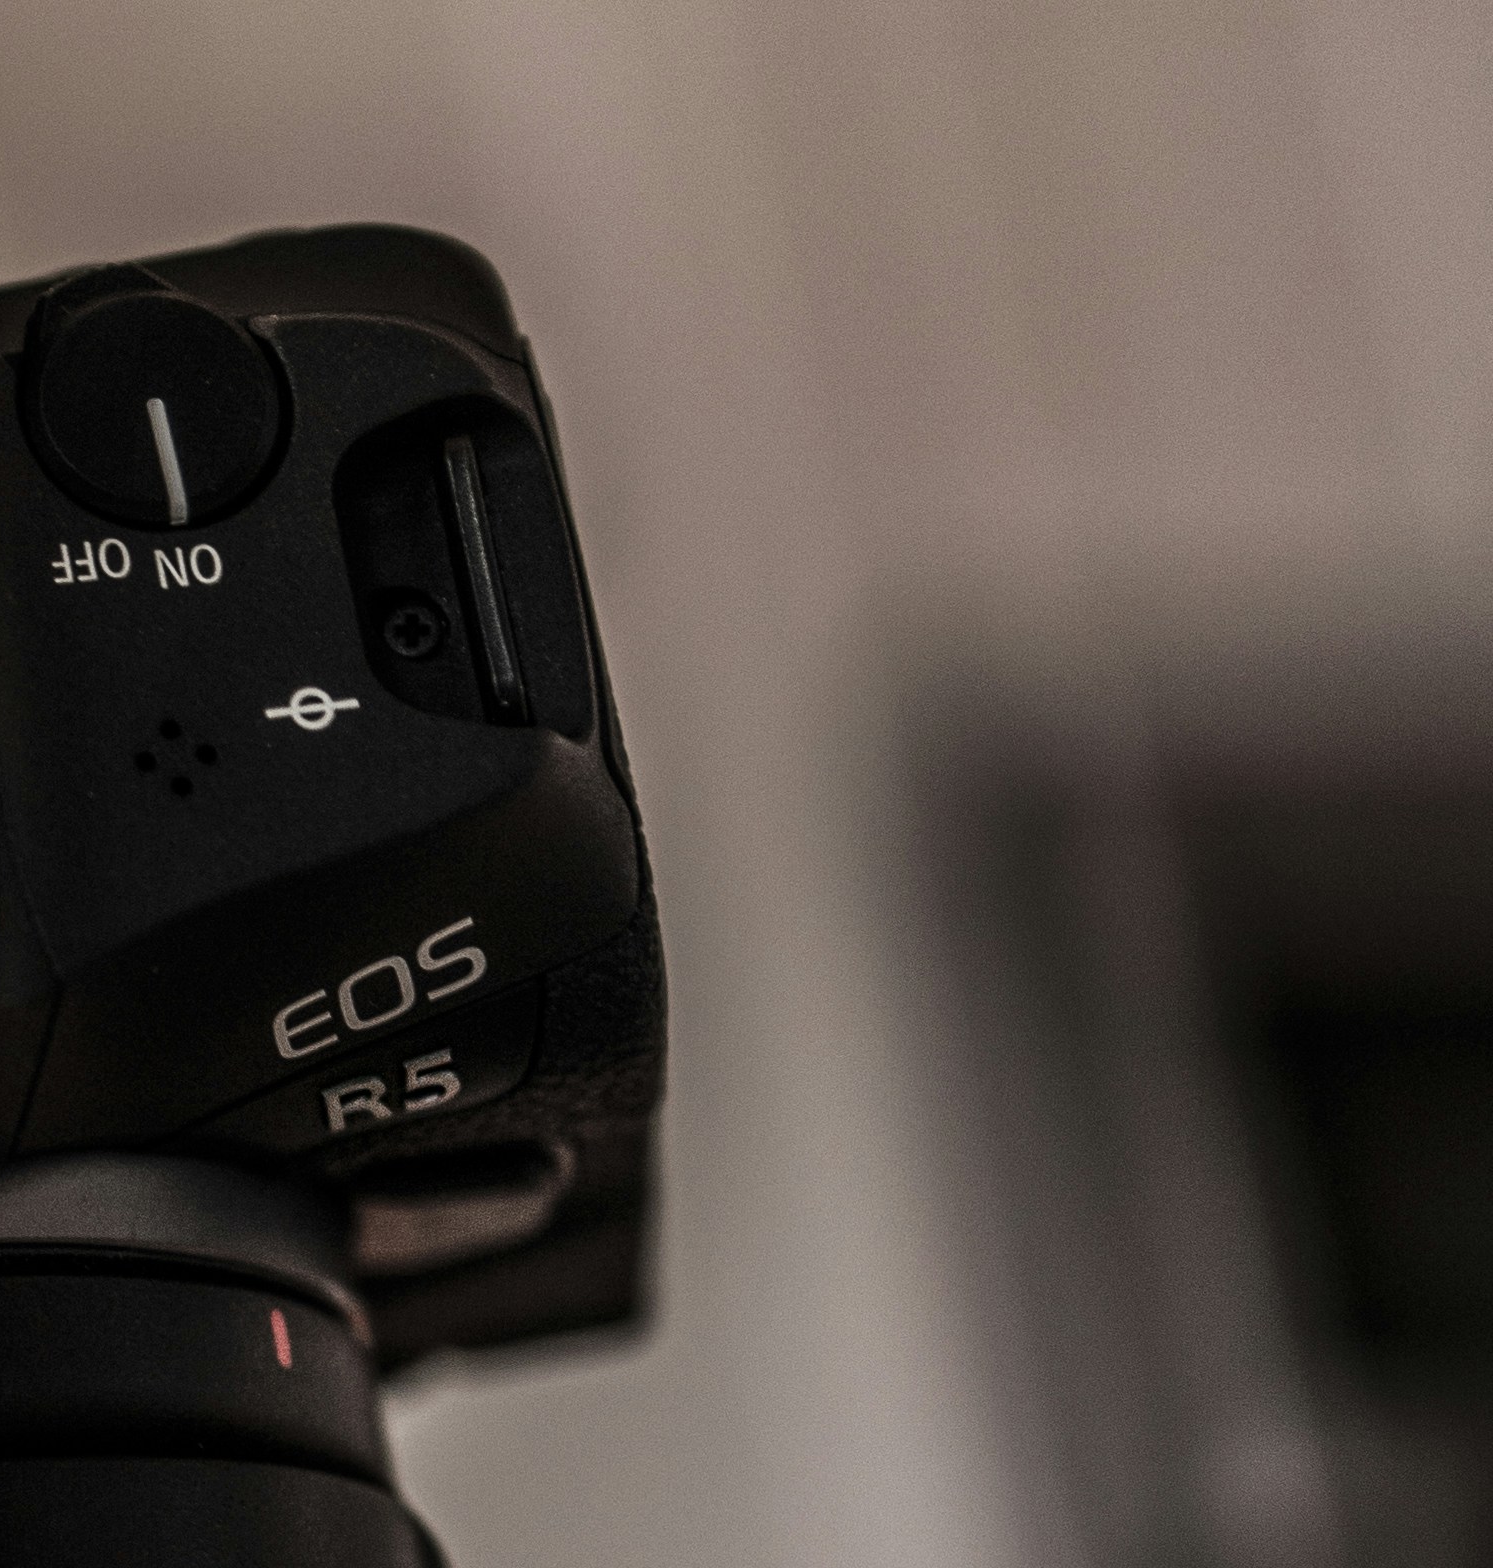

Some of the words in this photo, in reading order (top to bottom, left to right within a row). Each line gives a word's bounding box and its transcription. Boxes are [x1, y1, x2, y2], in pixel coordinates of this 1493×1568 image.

[51, 537, 132, 585] OFF
[153, 543, 223, 590] ON
[272, 916, 488, 1061] EOS
[320, 1047, 462, 1133] R5
